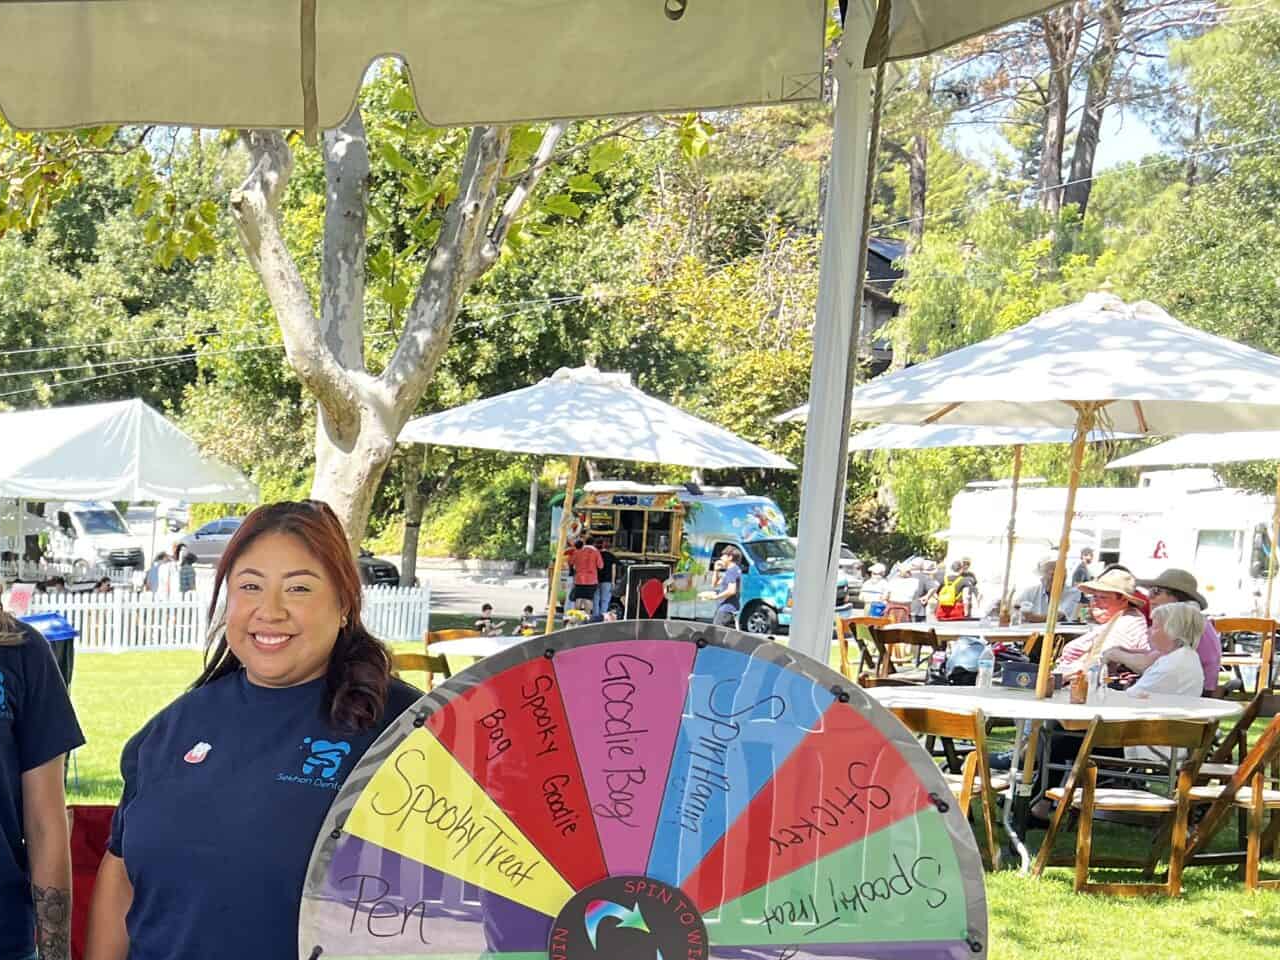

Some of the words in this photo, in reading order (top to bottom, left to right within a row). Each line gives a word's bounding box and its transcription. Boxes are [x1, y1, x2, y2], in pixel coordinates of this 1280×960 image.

[479, 708, 513, 761] Bag
[601, 654, 654, 760] Goodie
[313, 778, 344, 792] Denta
[521, 675, 560, 757] Spooky
[541, 774, 578, 836] Goodie
[371, 748, 485, 860] Spooky
[474, 815, 540, 887] Treat
[593, 766, 647, 828] Bag
[338, 874, 431, 944] Pen
[624, 880, 673, 905] SPIN
[673, 900, 696, 925] TO
